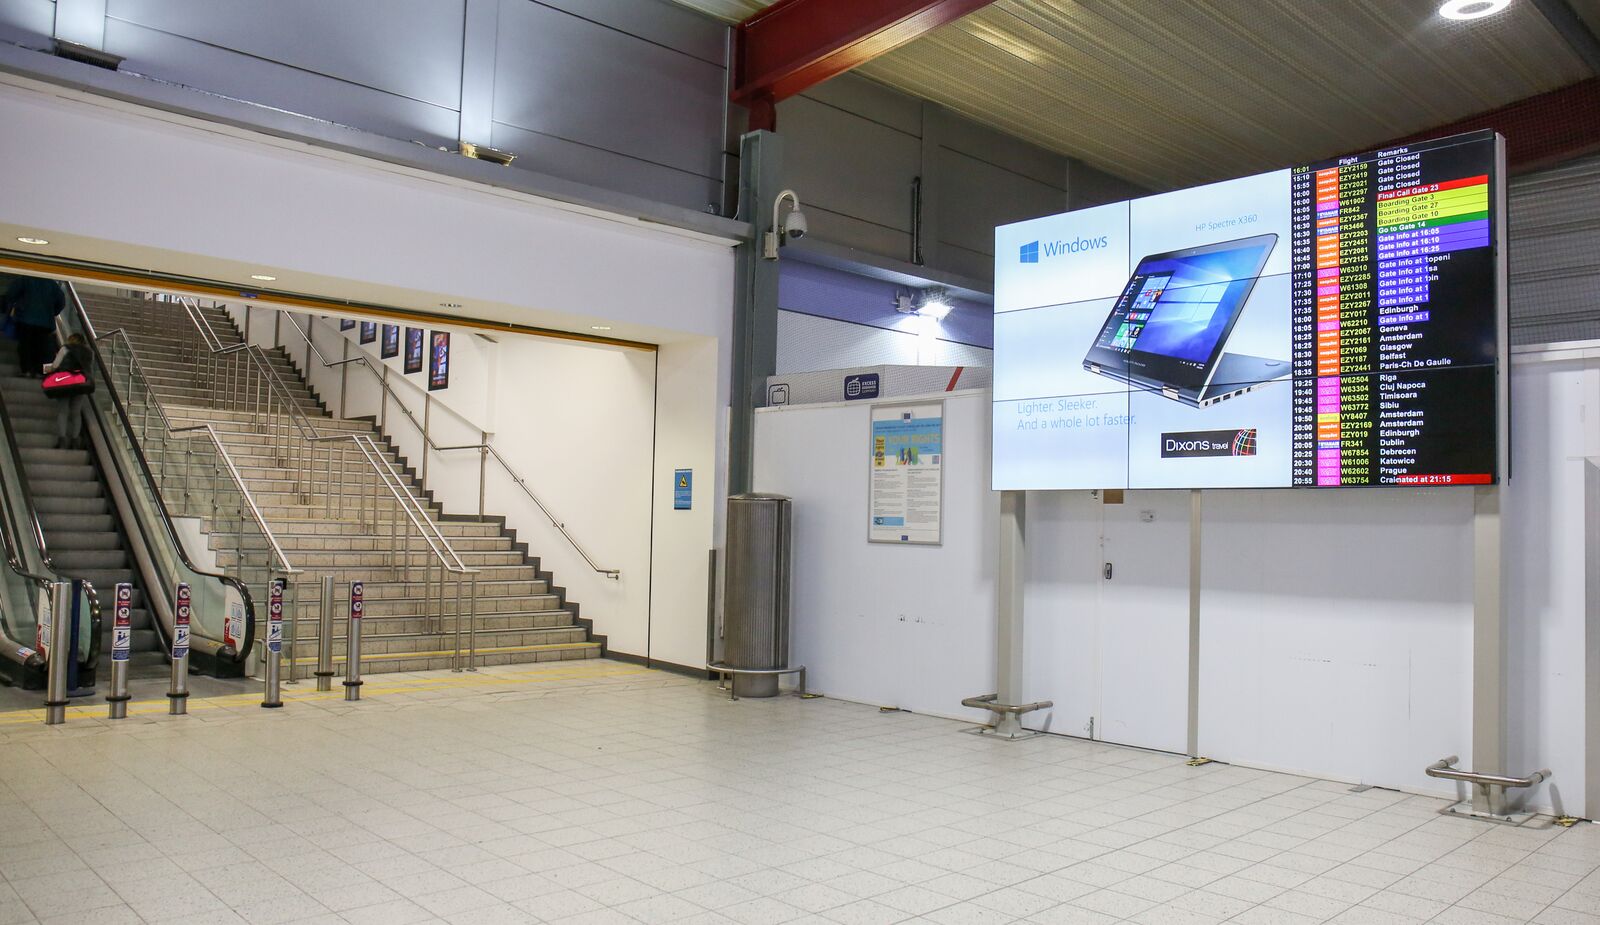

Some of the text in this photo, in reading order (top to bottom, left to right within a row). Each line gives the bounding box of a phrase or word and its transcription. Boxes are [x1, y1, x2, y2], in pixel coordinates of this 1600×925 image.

[1377, 147, 1407, 157] Remarks
[1339, 156, 1357, 167] Flight
[1395, 152, 1419, 162] Closed
[1395, 161, 1419, 171] Closed
[1293, 173, 1309, 181] 15:10
[1395, 170, 1419, 179] Closed
[1293, 181, 1309, 190] 15:55
[1395, 178, 1419, 188] Closed
[1293, 190, 1309, 198] 16:00
[1378, 191, 1394, 200] Final
[1378, 199, 1409, 208] Boarding
[1293, 206, 1309, 214] 16:05
[1339, 206, 1359, 214] FR842
[1378, 207, 1409, 216] Boarding
[1195, 214, 1258, 232] HP Spectre X360
[1378, 216, 1409, 227] Boarding
[1420, 227, 1439, 235] 16:05
[1339, 238, 1367, 247] EZY2451
[1420, 236, 1439, 244] 16:10
[1044, 234, 1107, 258] Windows
[1420, 245, 1439, 253] 16:25
[1339, 246, 1367, 256] EZY2081
[1339, 254, 1368, 264] EZY2125
[1339, 264, 1367, 273] W63010
[1340, 272, 1370, 282] EZY2285
[1340, 291, 1370, 300] EZY2011
[1340, 309, 1366, 318] EZY017
[1379, 304, 1418, 314] Edinburgh
[1379, 332, 1422, 342] Amsterdam
[1340, 355, 1366, 363] EZY187
[1380, 352, 1405, 360] Belfast
[1340, 364, 1370, 372] EZY2441
[1380, 361, 1411, 369] Paris-Ch
[1379, 383, 1394, 391] Cluj
[1018, 399, 1098, 417] Lighter. Sleeker.
[1379, 410, 1423, 418] Amsterdam
[1018, 413, 1136, 430] And a whole lot faster.
[1379, 419, 1423, 427] Amsterdam
[1380, 428, 1419, 437] Edinburgh
[1166, 439, 1228, 452] Dixons travel
